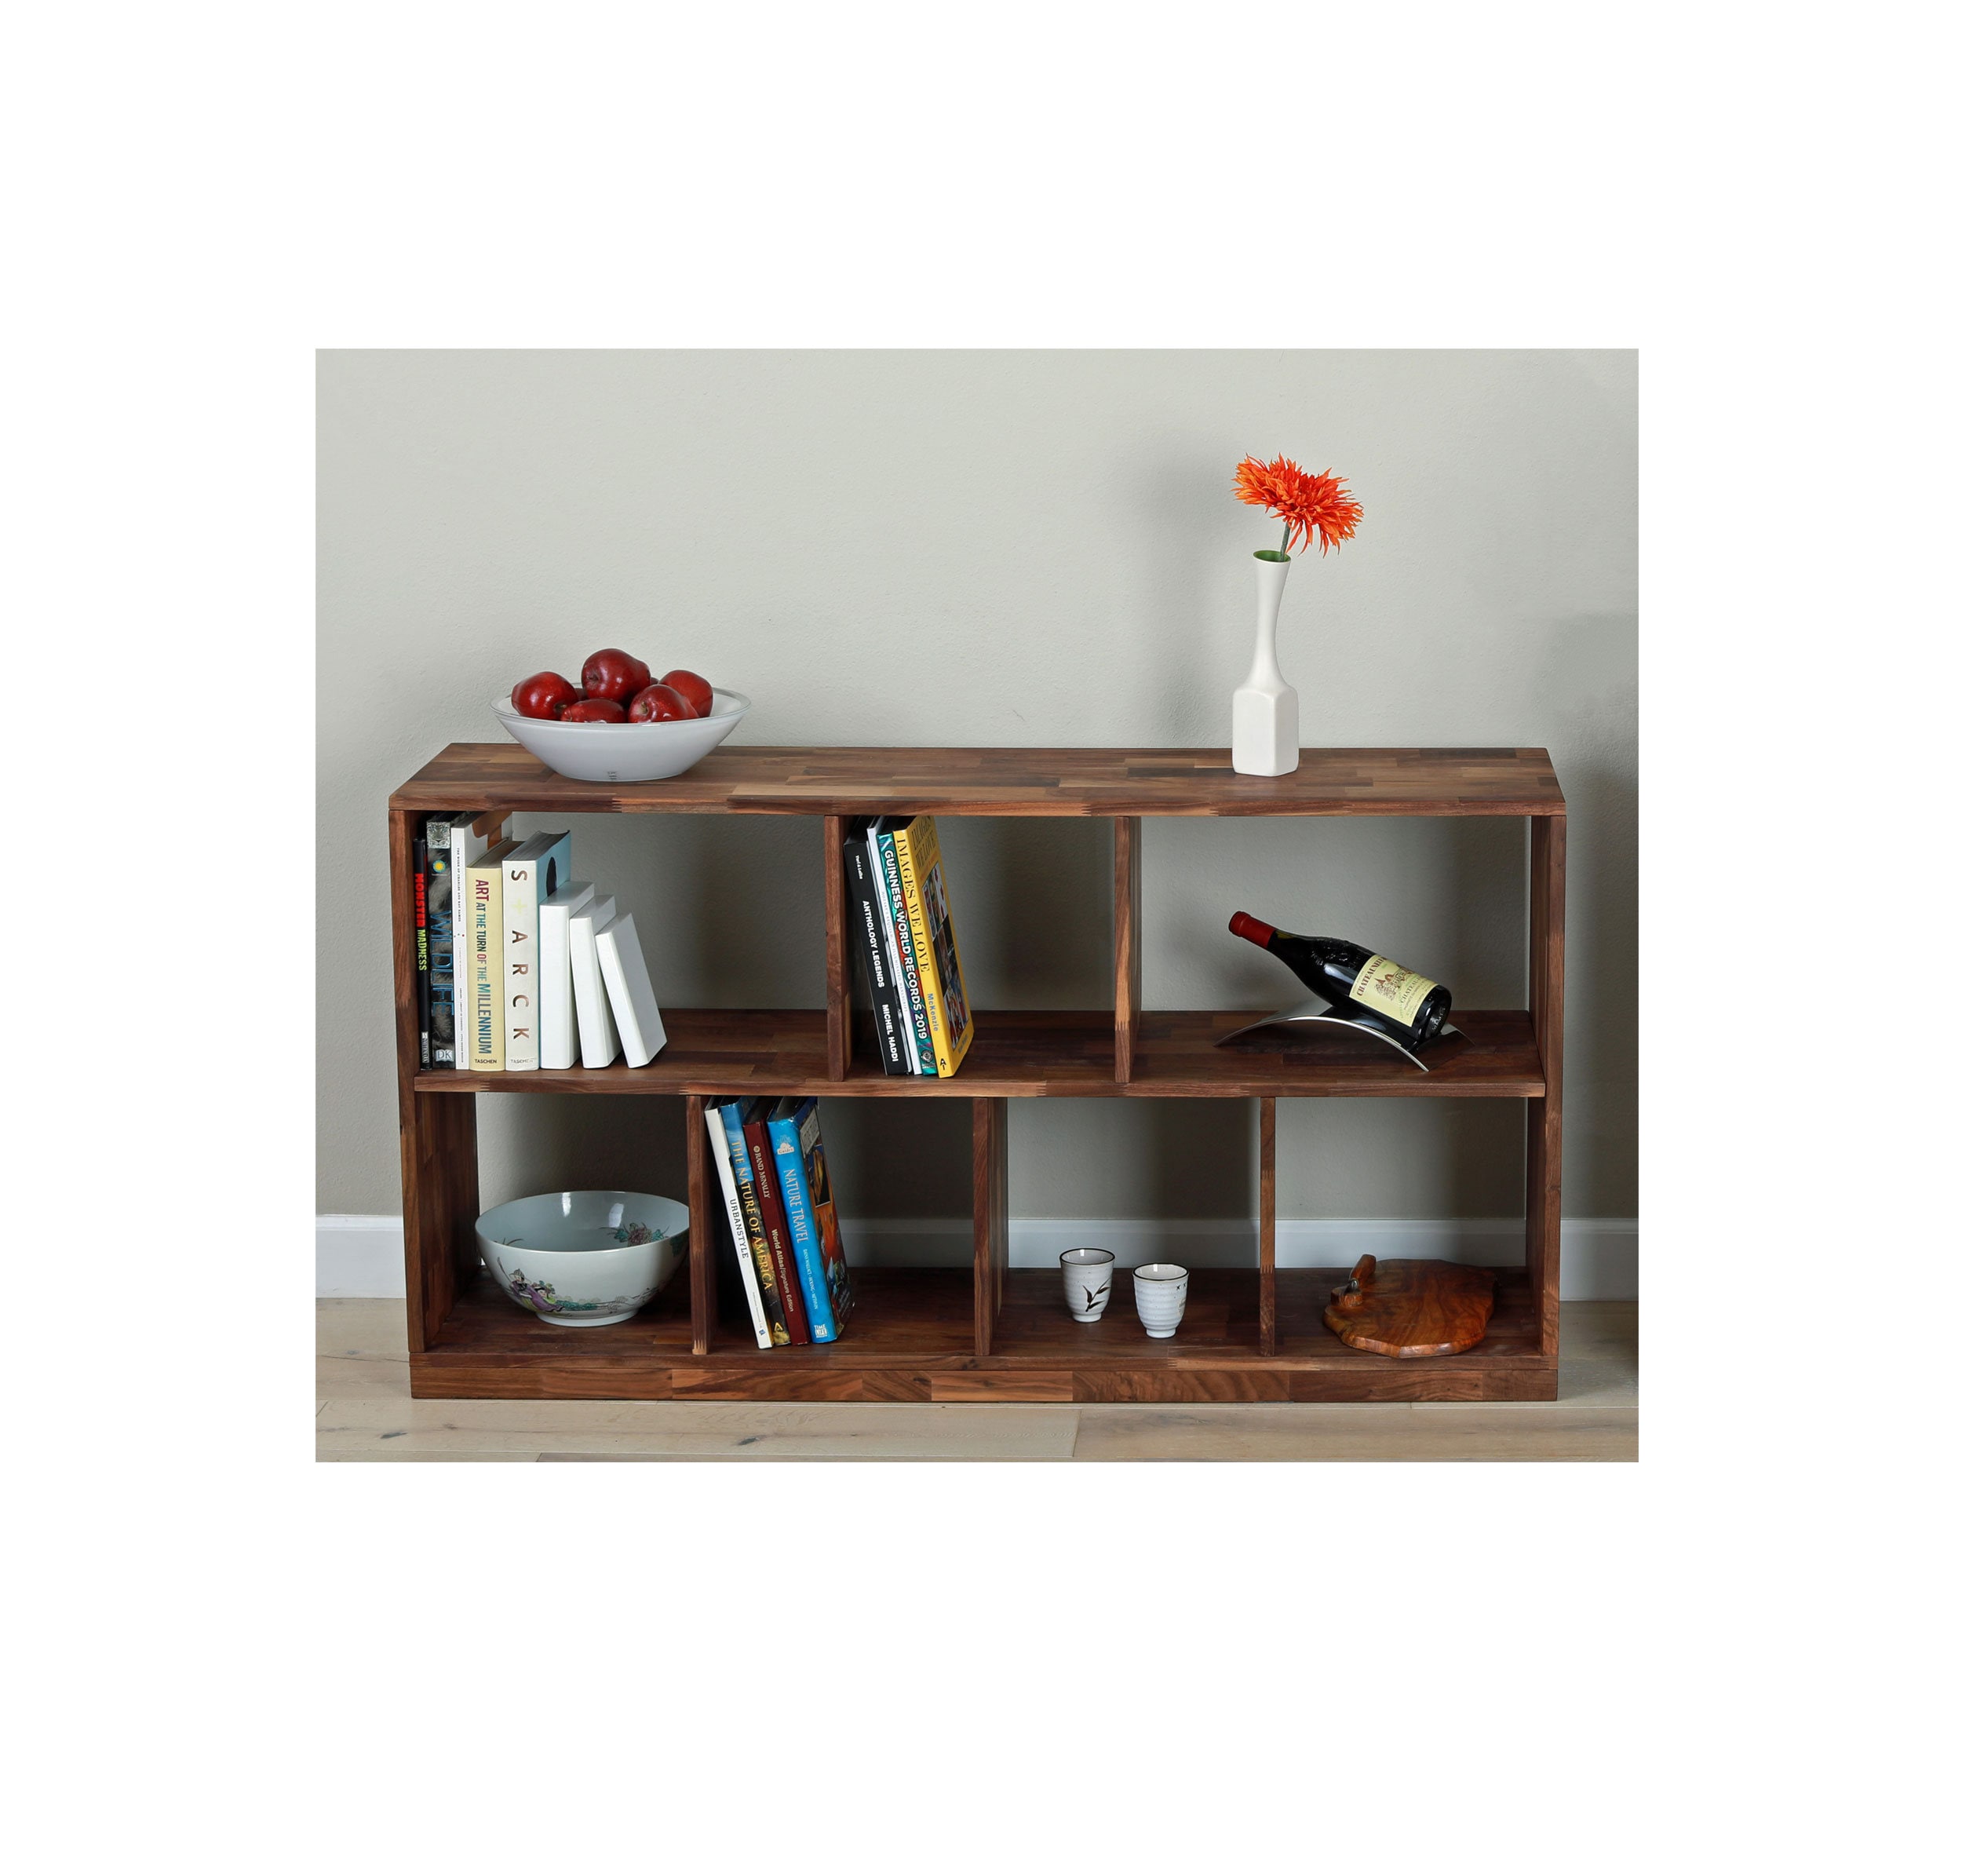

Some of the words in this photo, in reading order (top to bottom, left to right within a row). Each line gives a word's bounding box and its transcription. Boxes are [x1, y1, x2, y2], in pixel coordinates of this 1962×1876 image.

[896, 839, 916, 900] IMAGES
[414, 873, 425, 927] MONSTER
[476, 879, 490, 902] ART
[476, 902, 486, 913] AT
[476, 914, 487, 929] THE
[908, 903, 921, 927] WE
[416, 929, 428, 971] MADNESS
[476, 930, 487, 952] TURN
[476, 953, 487, 965] OF
[862, 900, 878, 948] ANTHOLOGY
[870, 950, 884, 987] LEGENDS
[884, 850, 904, 909] GUINNESS
[895, 910, 912, 954] WORLD
[904, 956, 922, 1011] RECORDS
[914, 1013, 928, 1039] 2019
[914, 931, 930, 973] LOVE
[429, 910, 454, 1016] WILDLIFE
[477, 966, 487, 981] THE
[477, 983, 492, 1054] MILLENNIUM
[927, 993, 940, 1031] McKenzie
[882, 1004, 893, 1035] MICHEL
[888, 1036, 899, 1062] HADDI
[438, 1050, 451, 1059] DK
[731, 1141, 744, 1164] THE
[753, 1152, 764, 1171] RAND
[735, 1167, 756, 1215] NATURE
[783, 1169, 801, 1206] NATURE
[793, 1208, 809, 1243] TRAVEL
[729, 1199, 749, 1259] URBANSTYLE
[747, 1217, 761, 1233] OF
[771, 1228, 781, 1250] World
[751, 1235, 773, 1290] AMERICA
